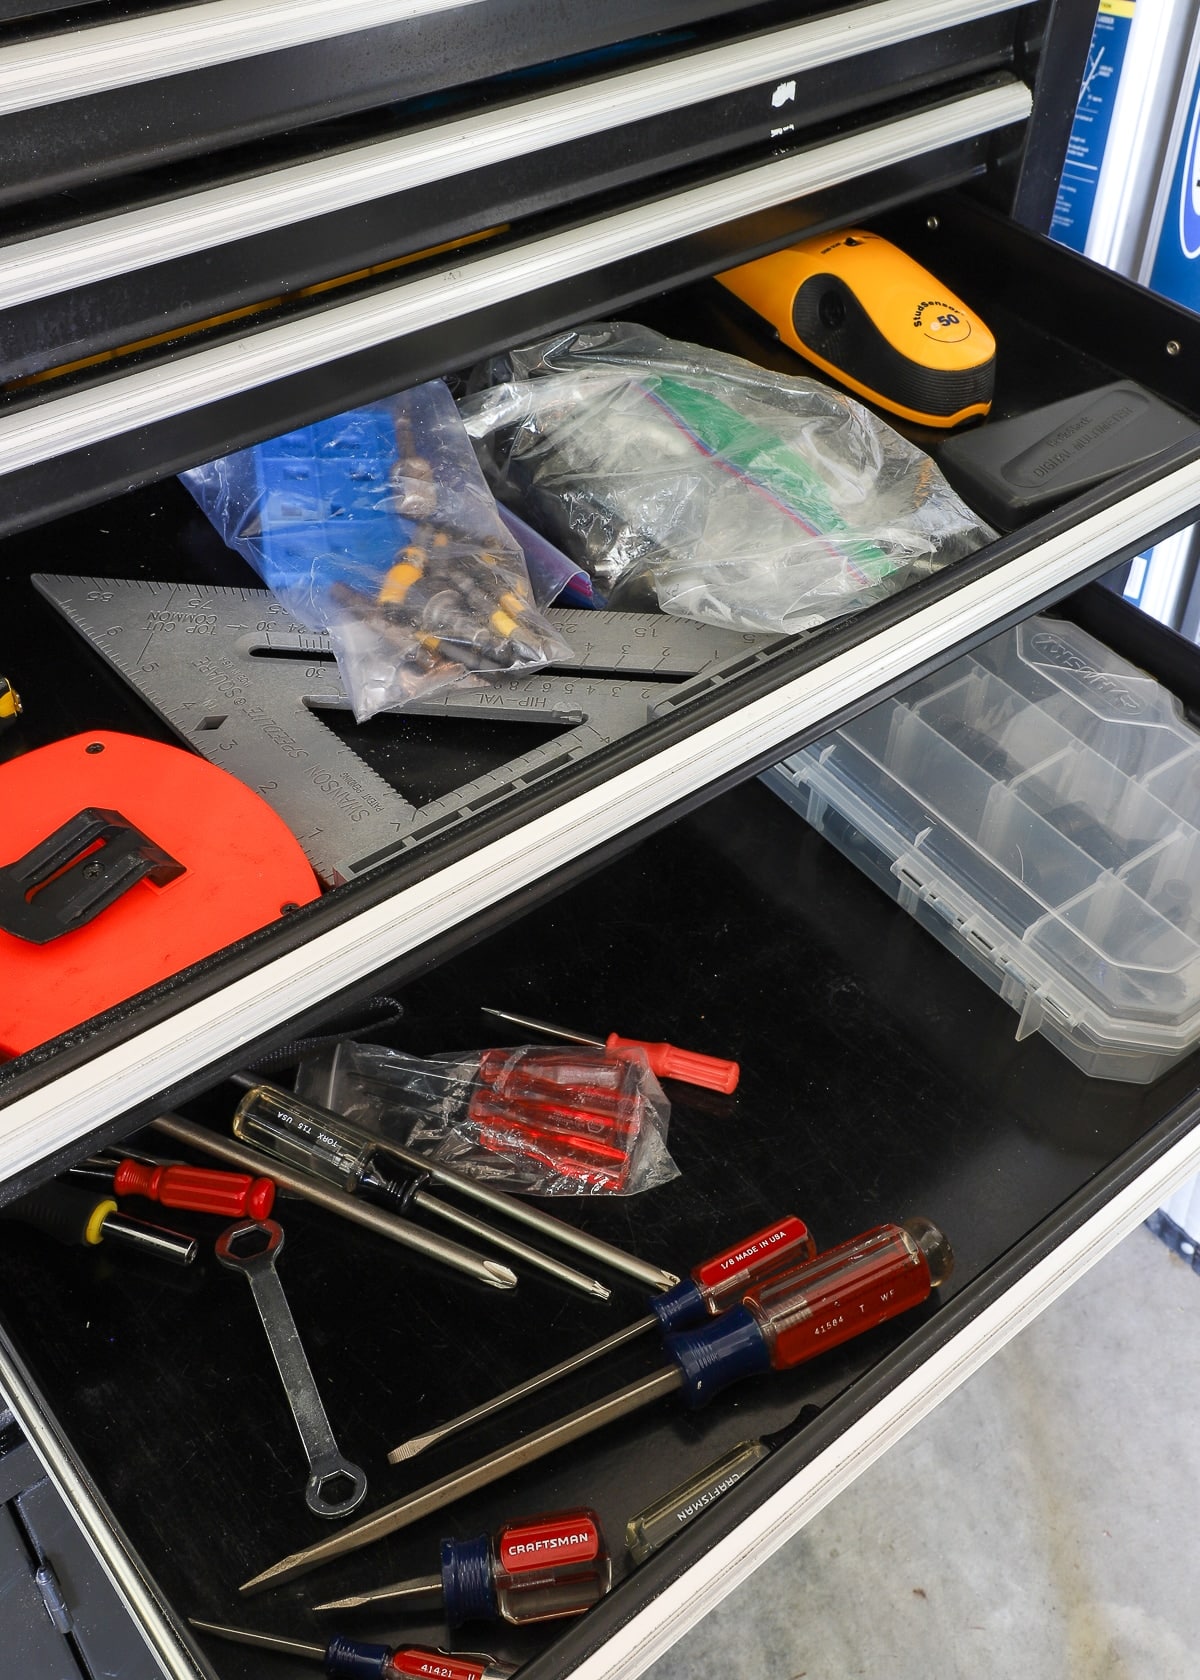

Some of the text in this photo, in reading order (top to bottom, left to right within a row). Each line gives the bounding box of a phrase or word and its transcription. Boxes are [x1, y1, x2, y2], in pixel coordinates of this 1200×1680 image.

[188, 598, 214, 610] 75
[148, 610, 217, 625] COMMON
[106, 625, 123, 636] 6
[141, 621, 216, 635] TOP CUT
[256, 621, 276, 632] 30
[634, 627, 658, 638] 15
[584, 642, 595, 651] 4
[621, 644, 631, 654] 3
[661, 646, 671, 657] 2
[142, 662, 160, 673] 5
[305, 667, 326, 679] 30
[509, 681, 520, 690] 8
[524, 681, 534, 692] 7
[541, 682, 551, 693] 6
[565, 683, 574, 695] 5
[586, 685, 596, 695] 4
[612, 686, 621, 698] 3
[641, 688, 650, 699] 2
[180, 701, 196, 711] 4
[219, 739, 238, 751] 3
[258, 780, 278, 794] 2
[304, 763, 370, 822] SWANSON
[361, 793, 385, 813] PATENT
[277, 1111, 338, 1148] TORX T15 USA
[720, 1231, 786, 1270] 1/8 MADE IN USA
[814, 1316, 844, 1336] 41584
[859, 1304, 865, 1313] T
[677, 1473, 741, 1522] CRAFTSMAN
[508, 1532, 589, 1556] CRAFTSMAN
[420, 1664, 453, 1678] 41421
